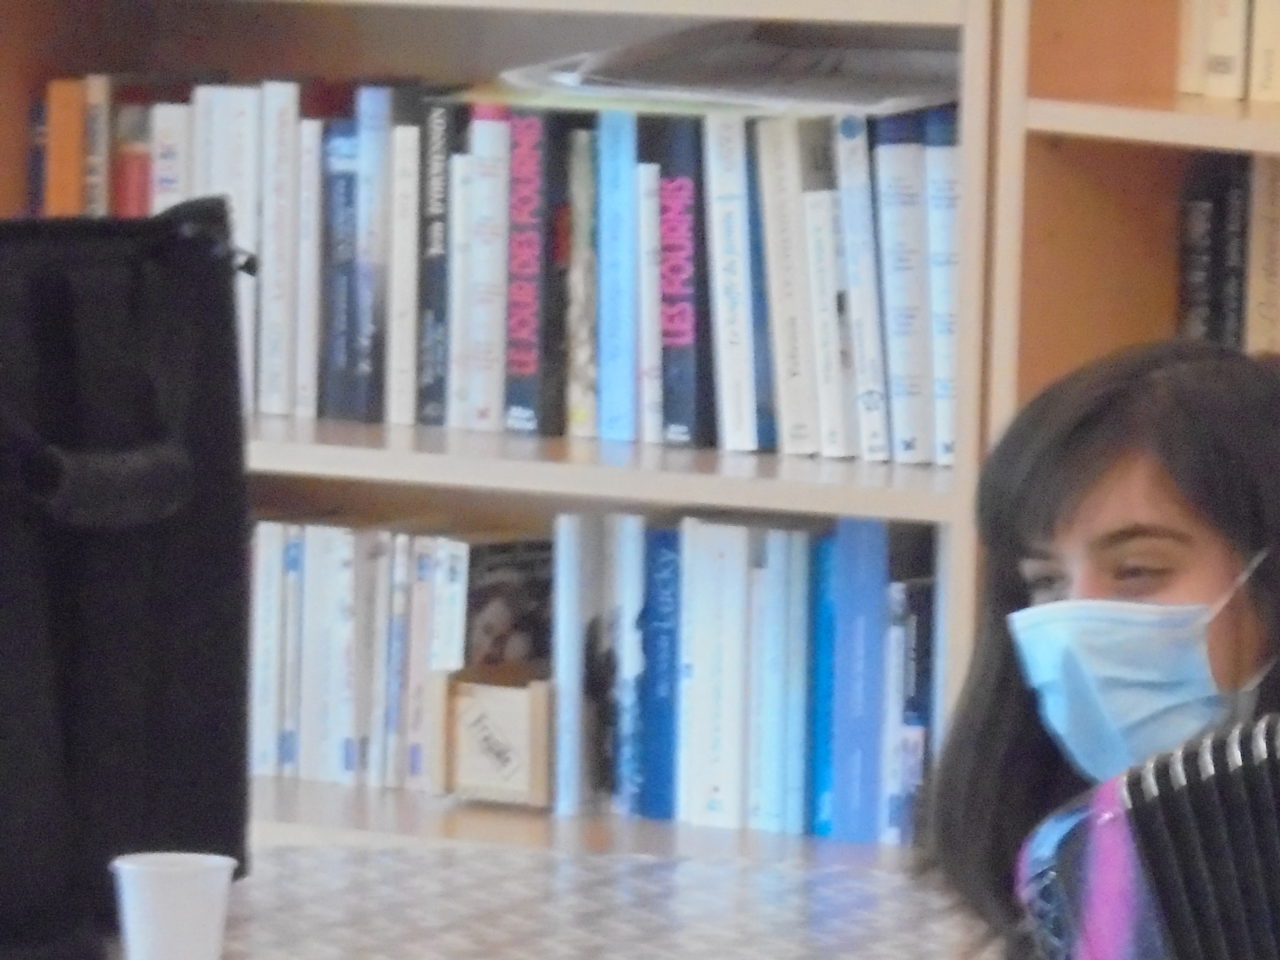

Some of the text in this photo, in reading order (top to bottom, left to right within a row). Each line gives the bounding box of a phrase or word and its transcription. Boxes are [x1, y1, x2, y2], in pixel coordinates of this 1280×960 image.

[508, 115, 542, 225] FOURMIS
[508, 230, 541, 275] DES
[660, 175, 696, 348] LES FOURMIS
